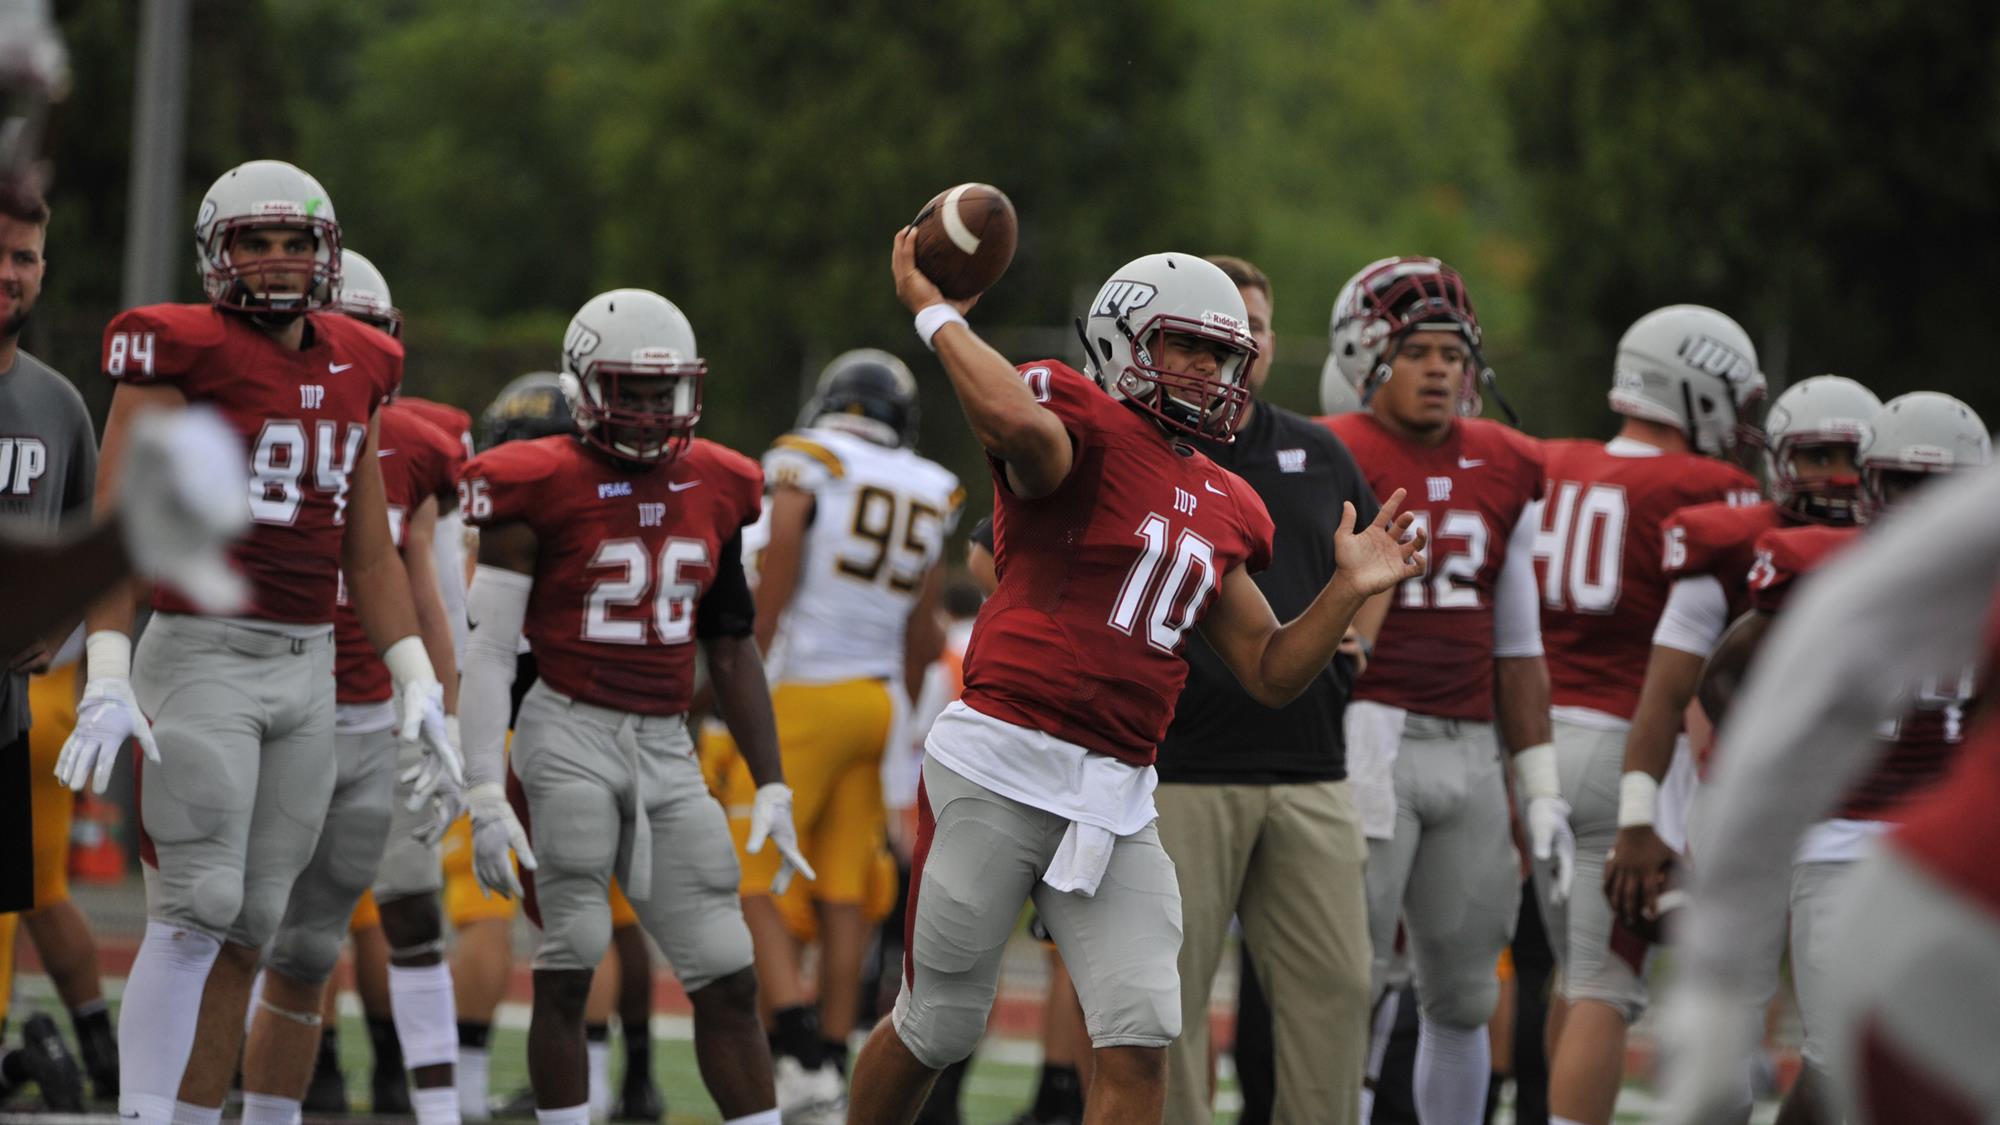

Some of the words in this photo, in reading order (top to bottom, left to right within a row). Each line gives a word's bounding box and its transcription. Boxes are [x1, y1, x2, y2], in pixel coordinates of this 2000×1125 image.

[1091, 280, 1158, 318] IUP
[1213, 314, 1238, 327] Riddell
[108, 333, 155, 376] 84
[300, 384, 325, 409] IUP
[1023, 366, 1052, 402] 0
[248, 418, 367, 526] 84
[638, 502, 666, 527] IUP
[1173, 486, 1198, 517] IUP
[834, 485, 939, 593] 95
[1400, 510, 1491, 610] 12
[1530, 481, 1628, 615] 40
[581, 536, 709, 646] 26
[1107, 511, 1216, 656] 10
